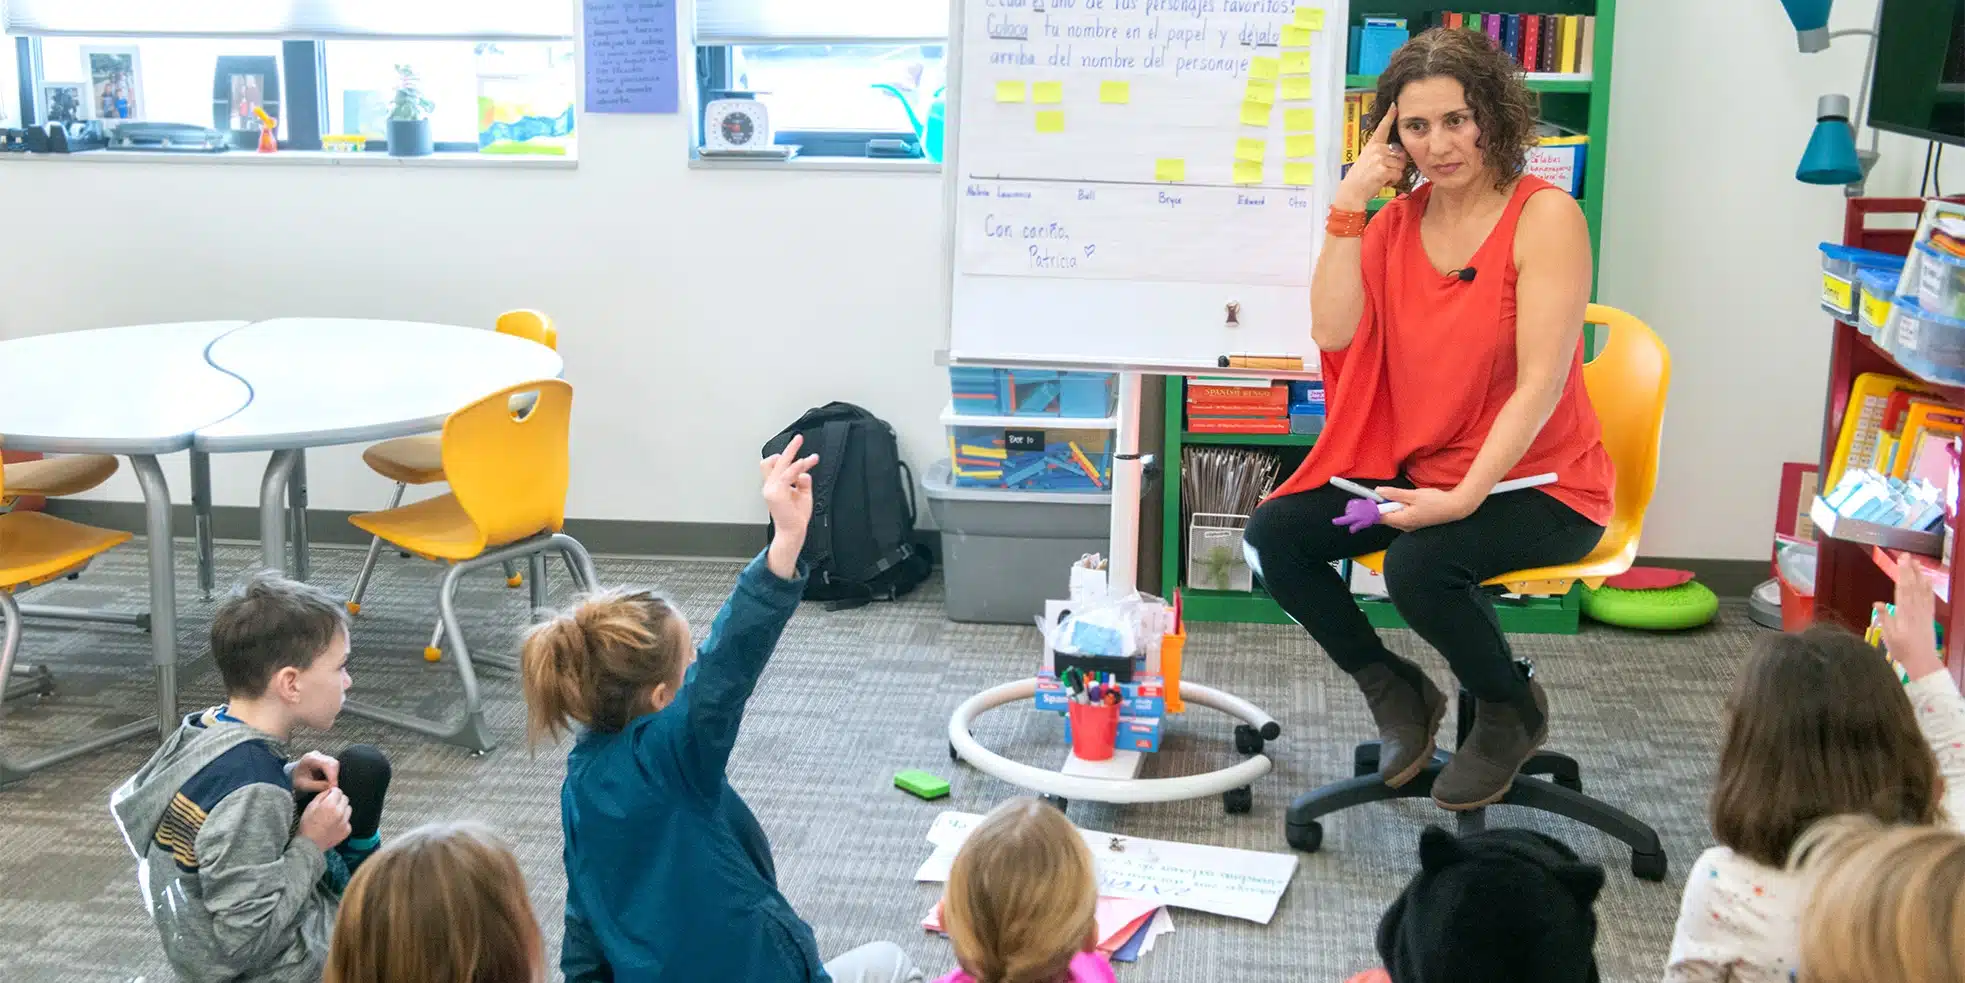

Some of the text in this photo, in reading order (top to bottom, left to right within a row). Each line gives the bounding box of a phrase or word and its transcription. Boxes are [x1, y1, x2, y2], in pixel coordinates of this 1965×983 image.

[986, 12, 1280, 50] Coloca tu nombre en el papel y déjalo
[988, 44, 1249, 79] arriba del nombre del personaje
[984, 213, 1013, 238] Con
[1028, 244, 1077, 269] Patricia
[1204, 388, 1241, 397] SPANISH
